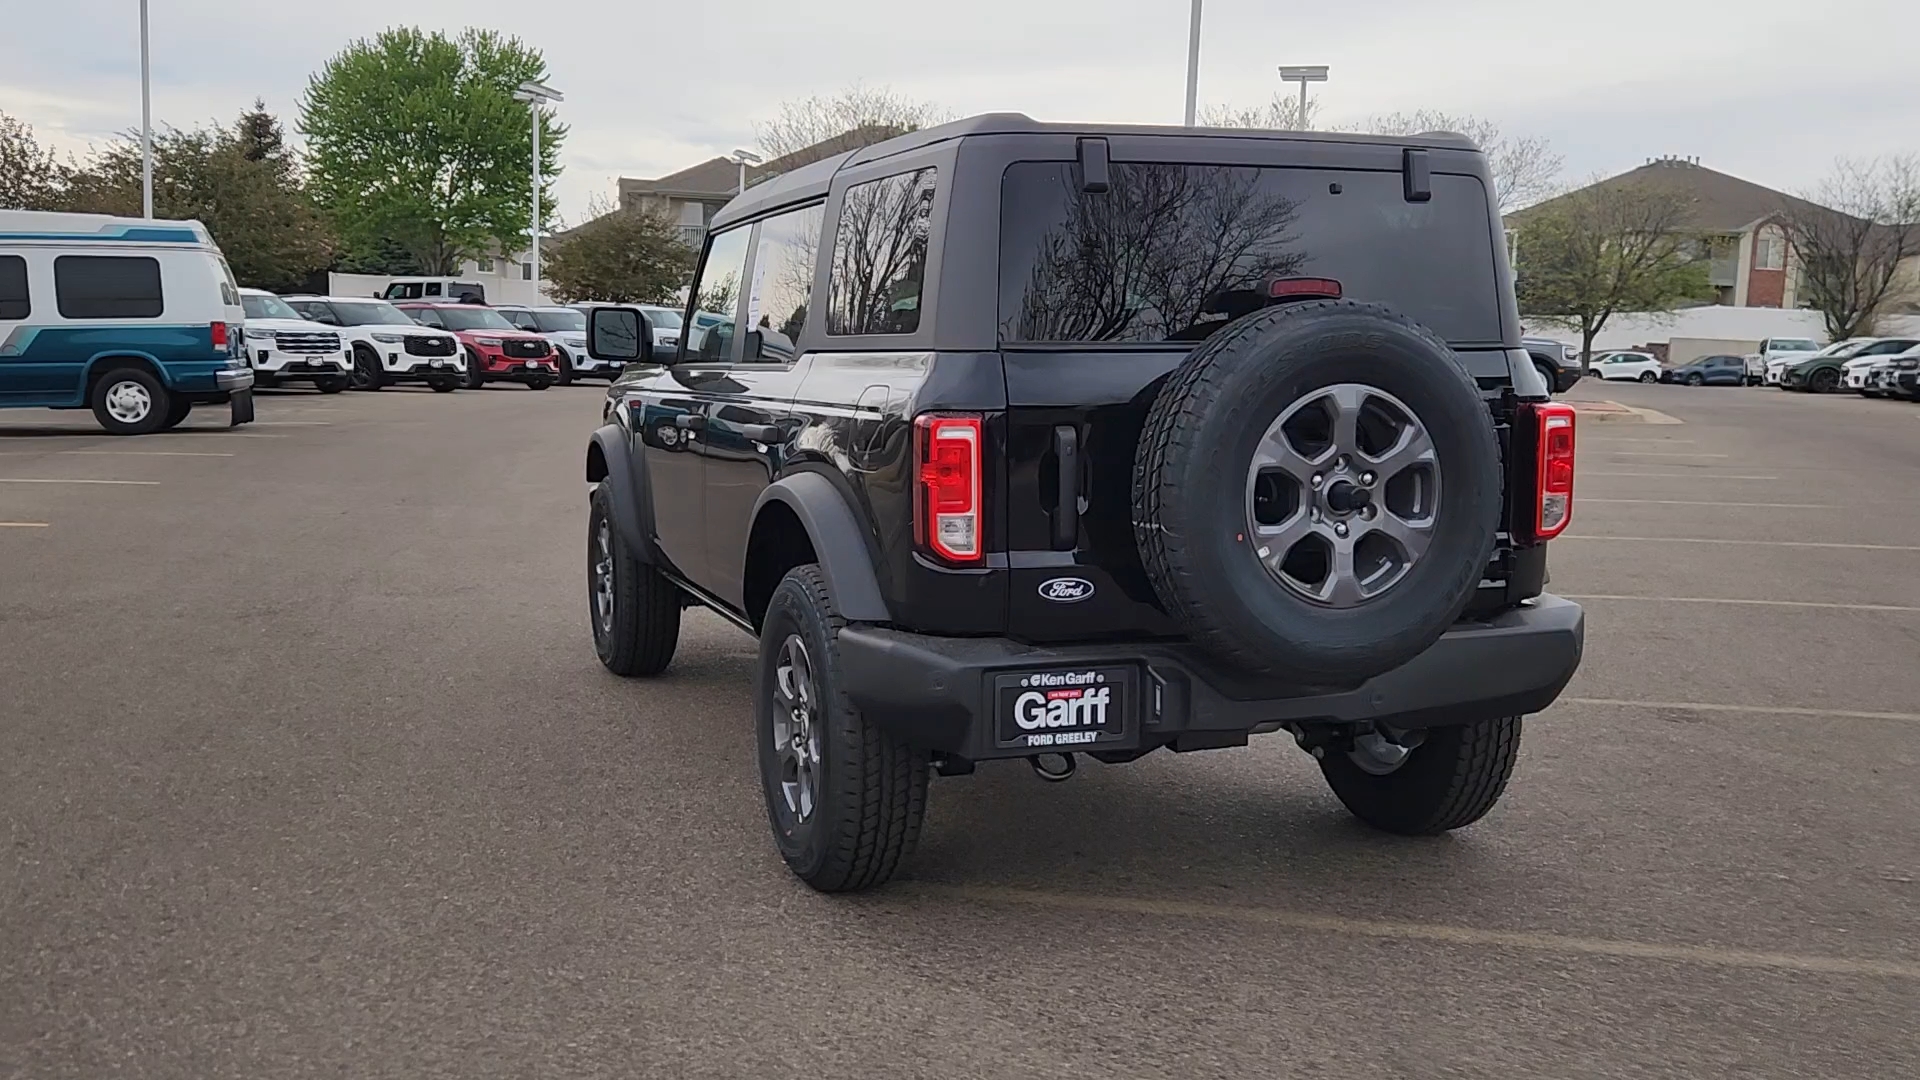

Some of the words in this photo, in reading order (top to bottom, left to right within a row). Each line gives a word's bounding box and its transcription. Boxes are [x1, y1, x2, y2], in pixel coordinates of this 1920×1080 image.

[1049, 581, 1084, 597] Ford
[1041, 674, 1065, 686] Ken
[1065, 671, 1096, 685] Garff
[1014, 687, 1110, 730] Garff
[1027, 734, 1053, 747] FORD
[1055, 731, 1098, 745] GREELEY
